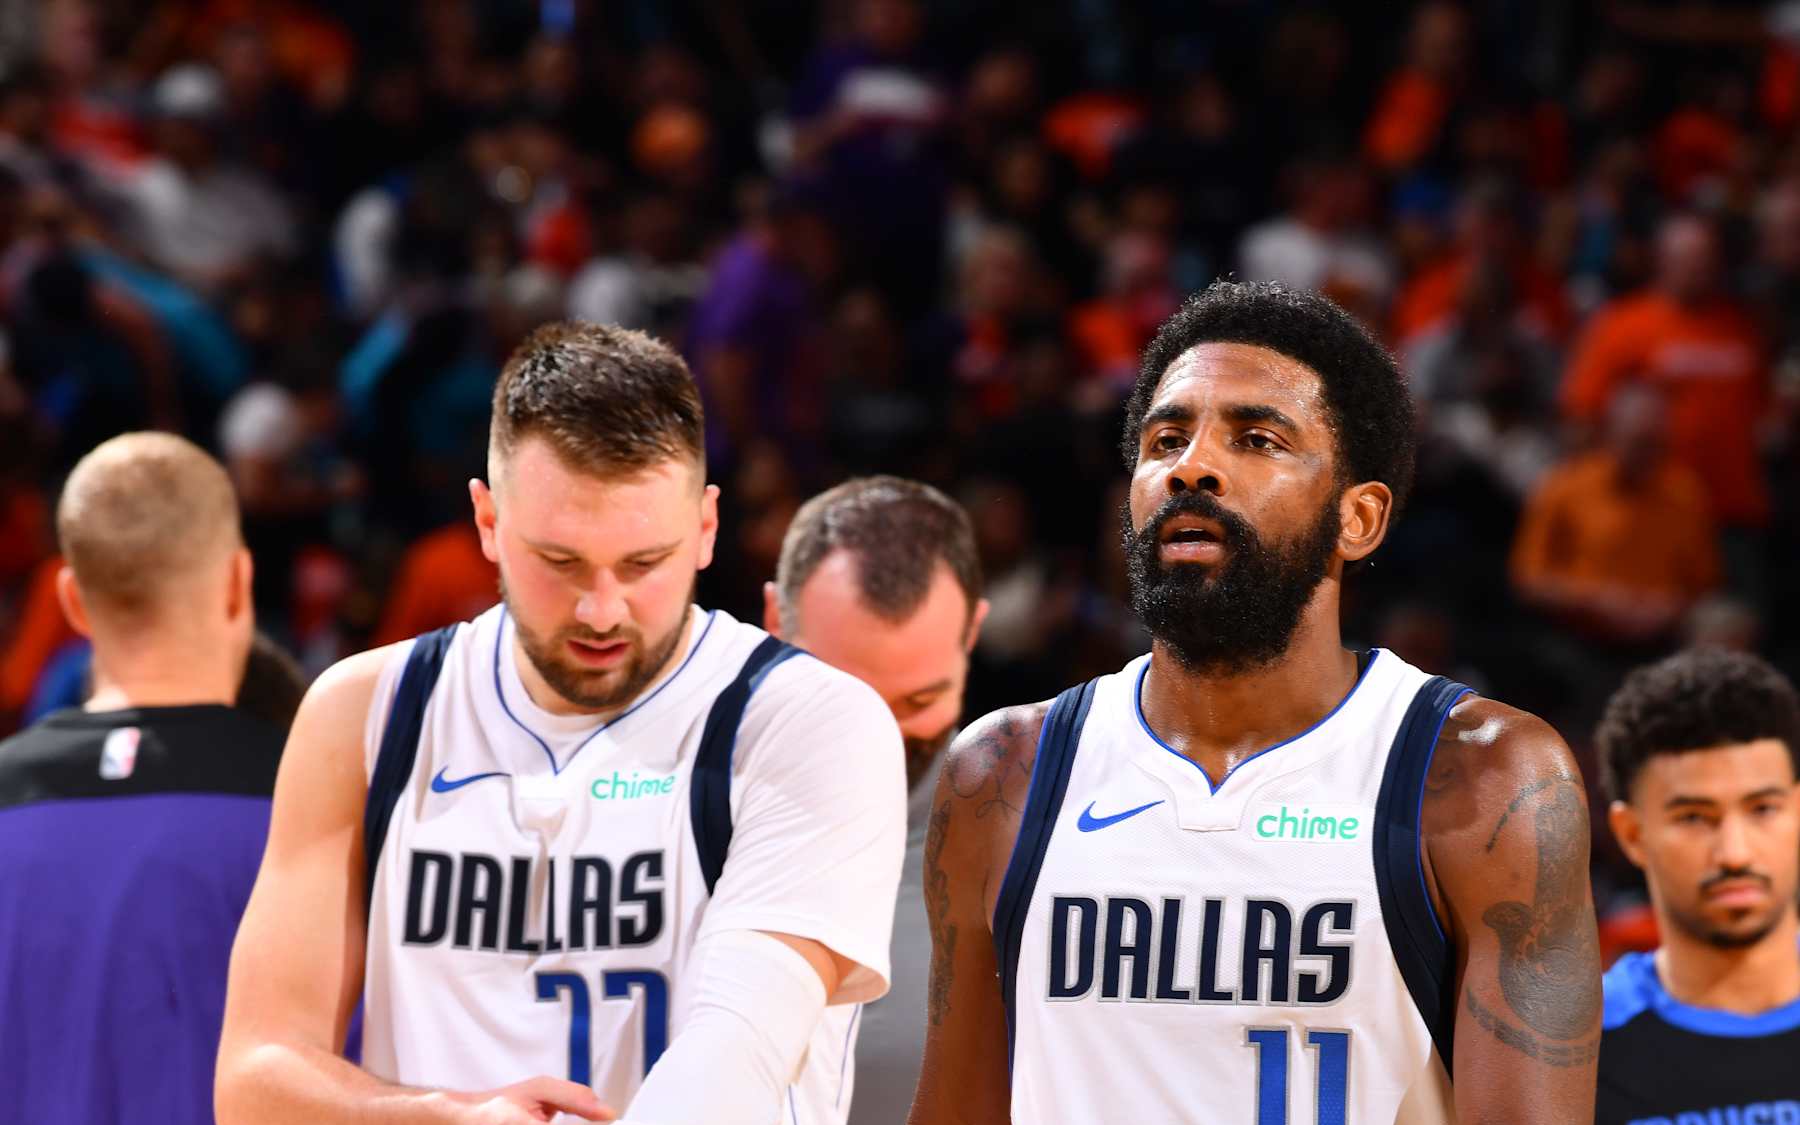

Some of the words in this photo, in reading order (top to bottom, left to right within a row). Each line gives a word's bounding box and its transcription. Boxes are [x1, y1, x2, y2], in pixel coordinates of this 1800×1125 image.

[591, 771, 676, 800] chime
[1256, 806, 1360, 840] chime
[401, 847, 666, 955] DALLAS
[1045, 895, 1358, 1007] DALLAS
[534, 967, 670, 1088] 77
